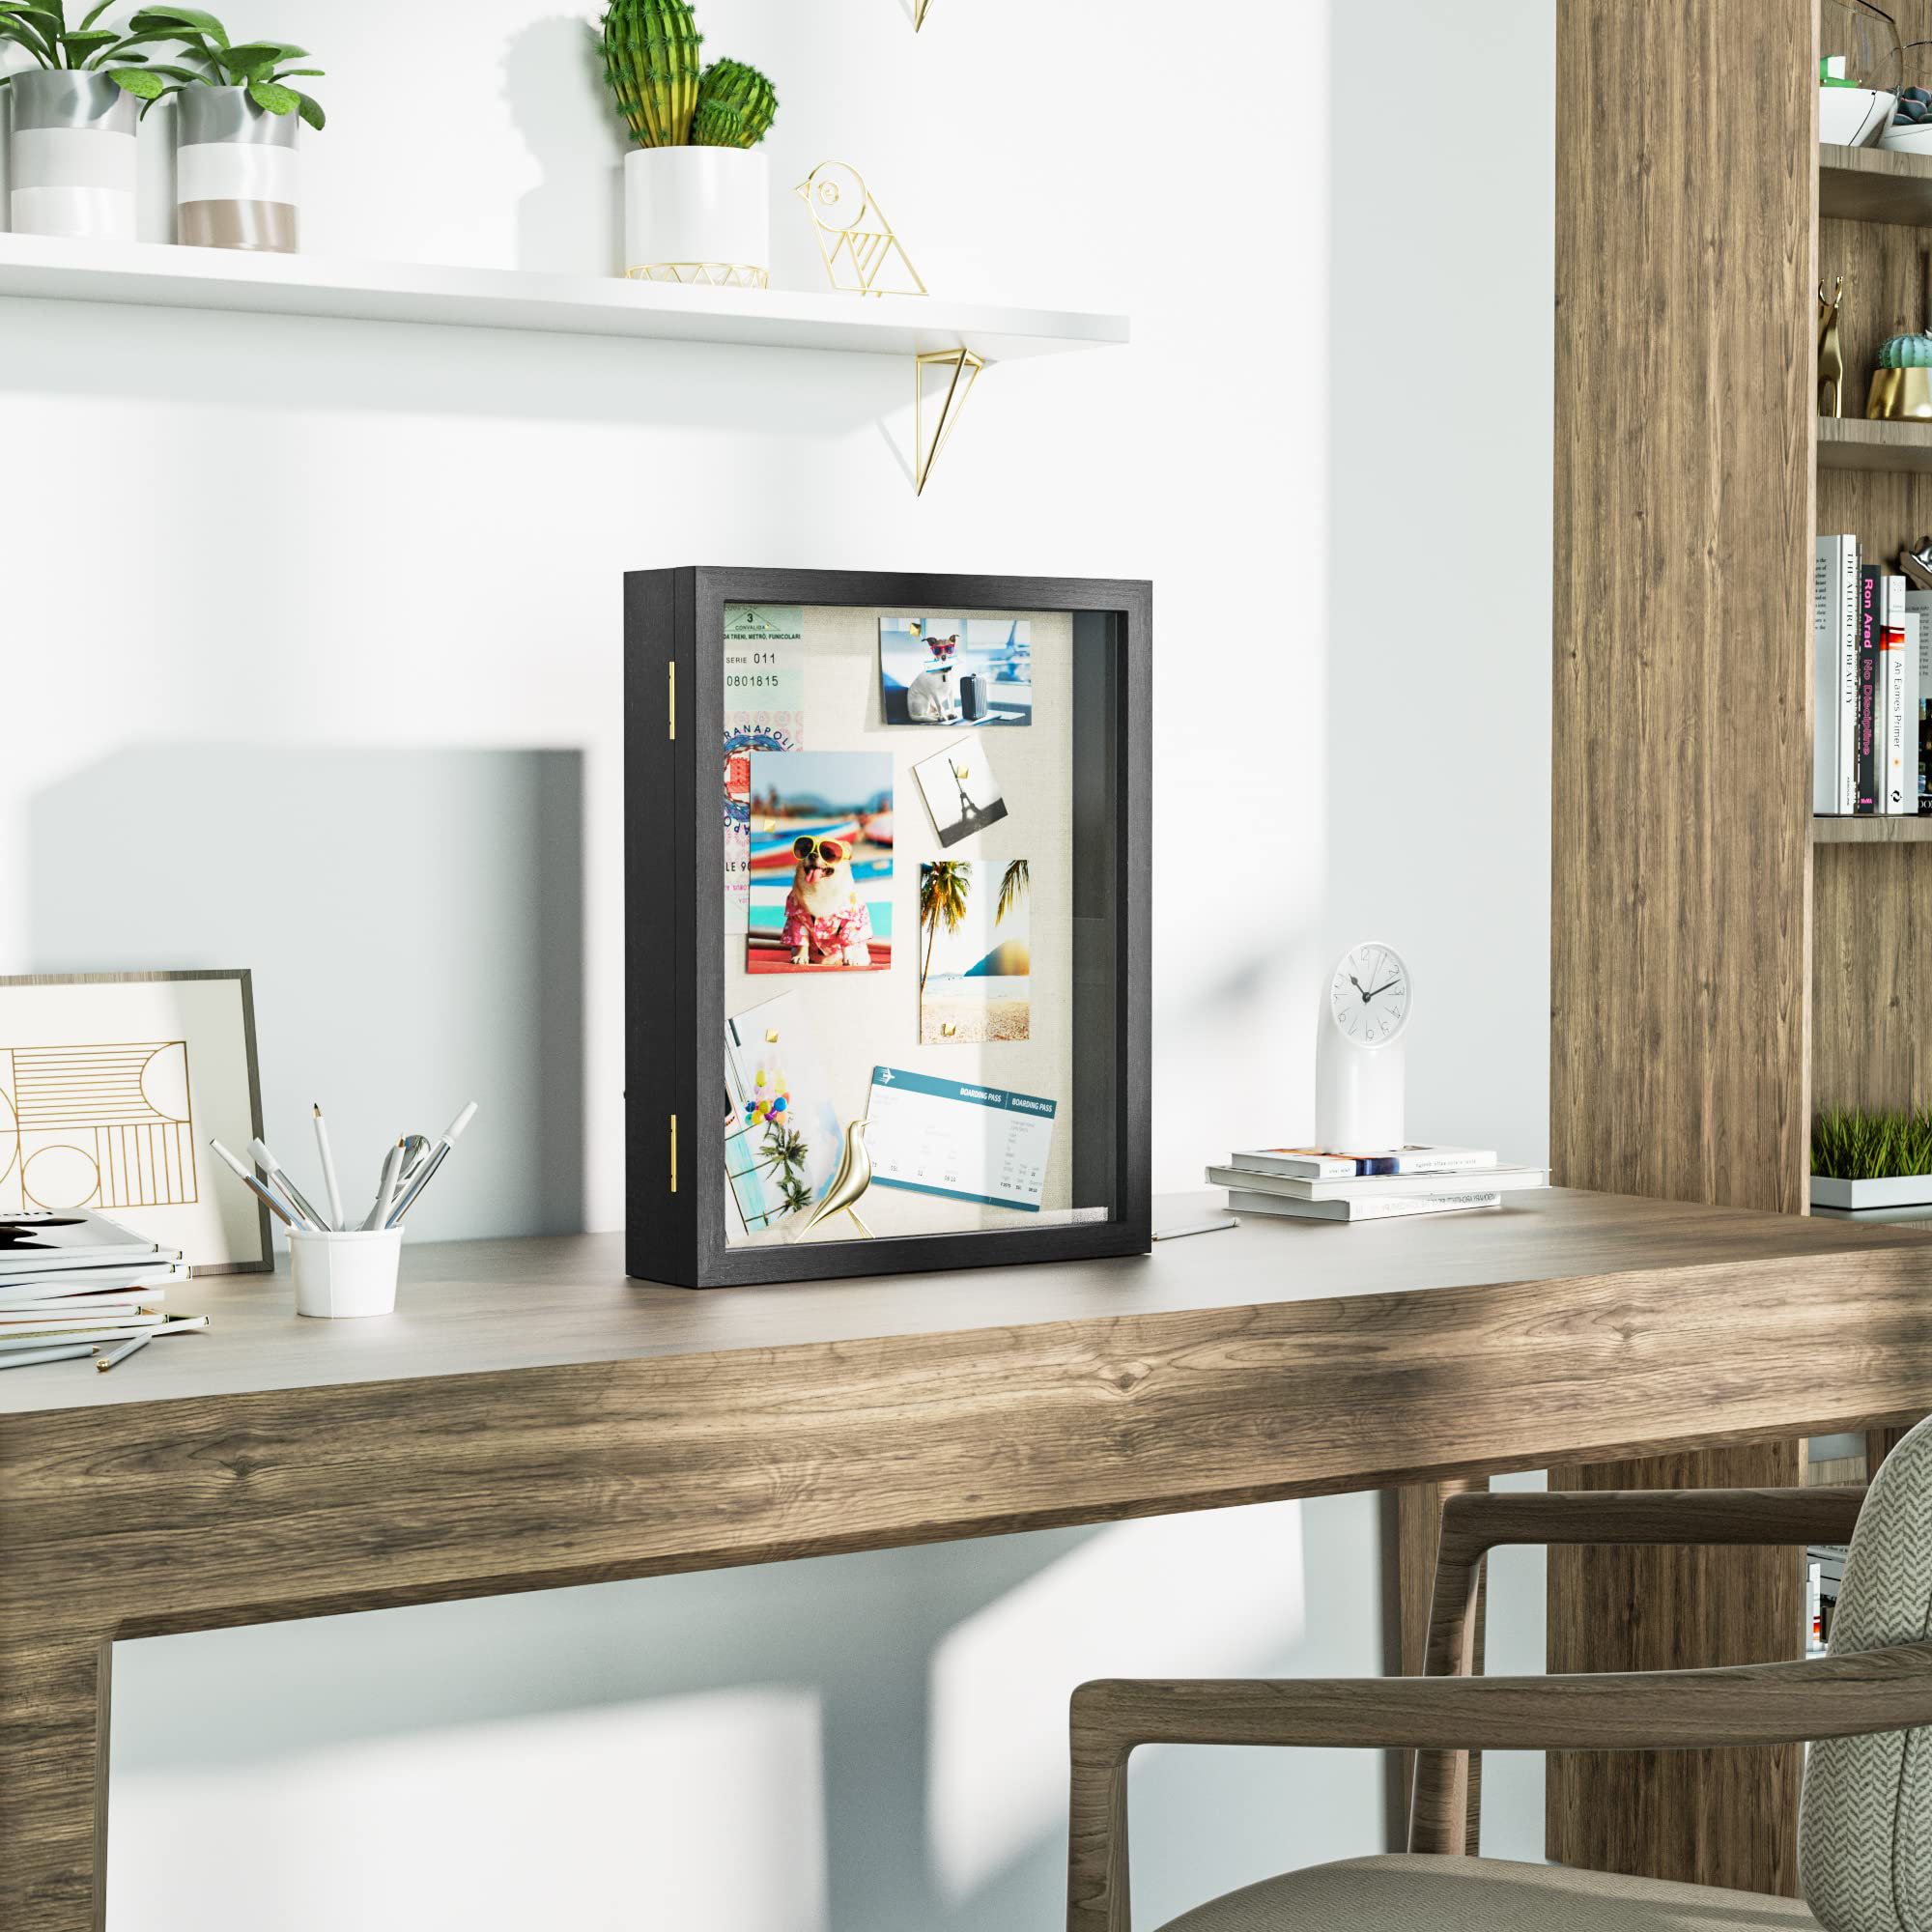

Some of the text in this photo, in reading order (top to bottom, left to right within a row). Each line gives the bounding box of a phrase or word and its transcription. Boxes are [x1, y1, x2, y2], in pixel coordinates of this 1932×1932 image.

[747, 612, 754, 623] 3
[1846, 633, 1853, 649] OF
[753, 652, 775, 664] 011
[1861, 579, 1874, 755] Ron Arad No Discipline
[726, 675, 779, 687] 0801815
[1893, 661, 1903, 749] An Eames Primer
[960, 1088, 1002, 1102] BOARDING PASS
[1011, 1097, 1053, 1113] BOARDING PASS
